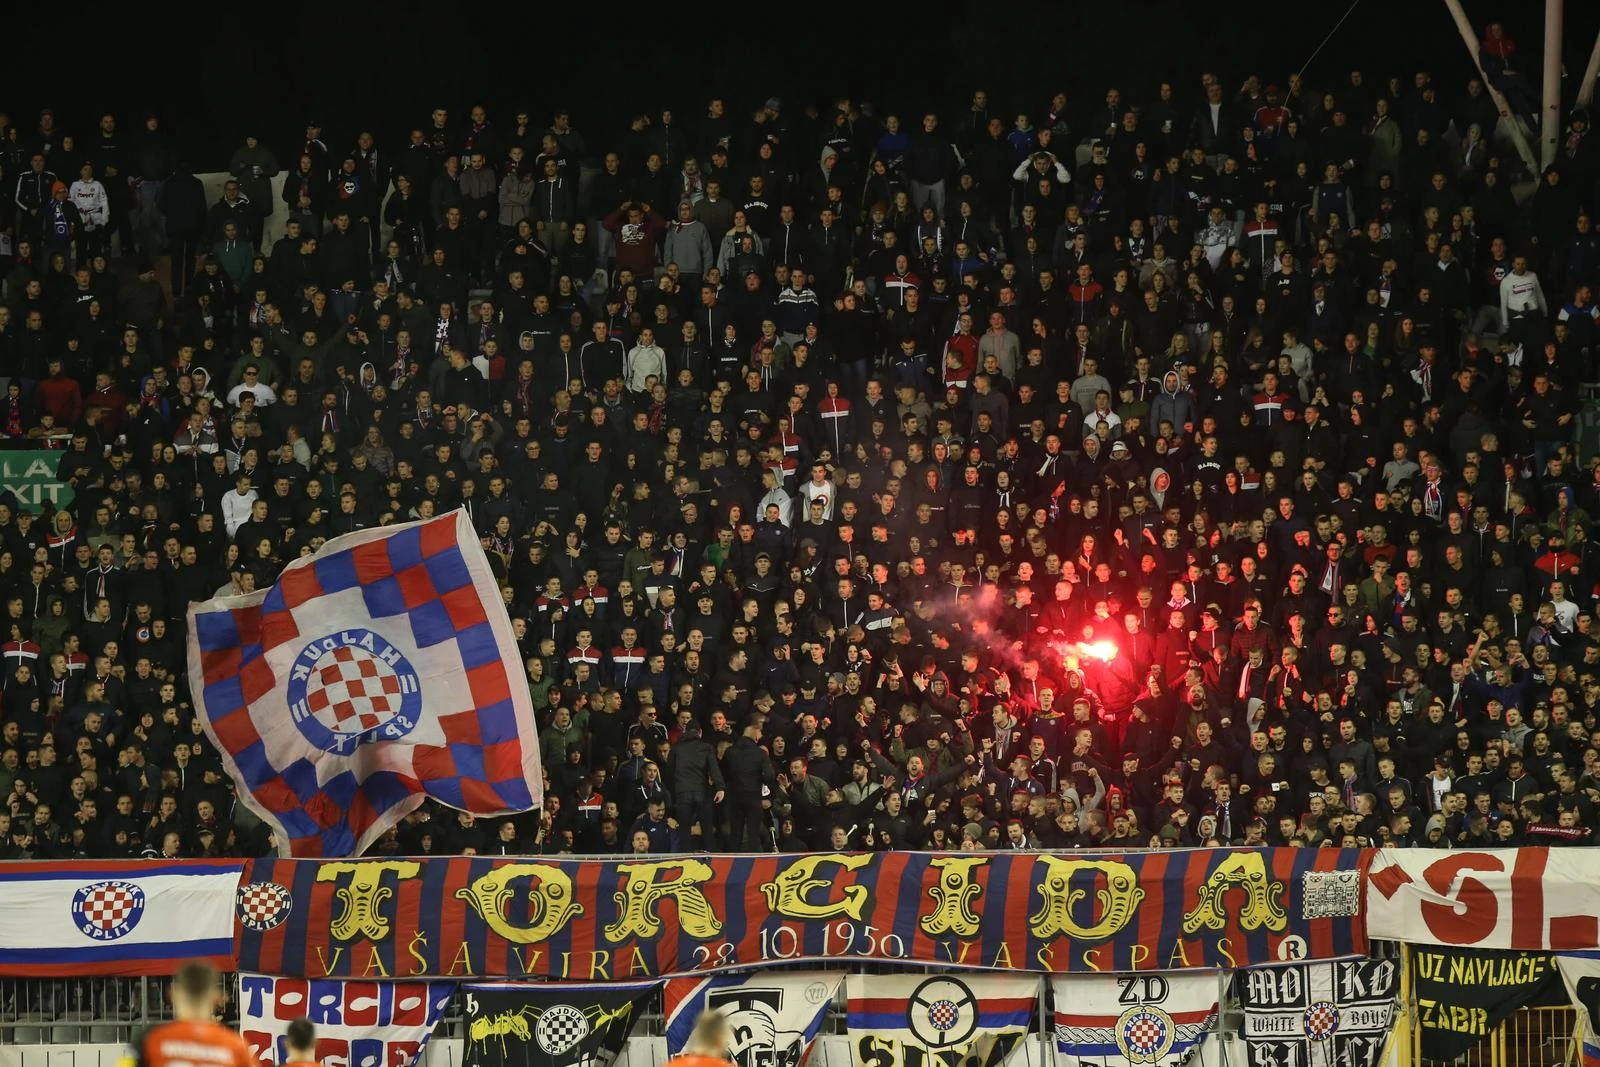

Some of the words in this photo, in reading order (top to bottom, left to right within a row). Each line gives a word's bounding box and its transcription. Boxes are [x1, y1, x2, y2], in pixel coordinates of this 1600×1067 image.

[4, 458, 60, 478] LA
[317, 852, 1287, 943] TORCIDA
[83, 922, 130, 939] SPLIT
[241, 914, 277, 930] SPLIT
[315, 929, 474, 977] VAŠA
[511, 946, 651, 980] VIRA
[759, 926, 801, 960] 10.
[821, 922, 909, 959] 1950.
[1418, 951, 1445, 983] UZ
[1449, 952, 1546, 987] NAVIJAČE
[1117, 975, 1169, 1006] ZD
[542, 1007, 584, 1024] HAJDUK
[1127, 1013, 1165, 1028] HAJDUK
[1252, 1016, 1295, 1033] WHITE
[1350, 1009, 1387, 1027] BOYS
[1419, 998, 1491, 1036] ZABR
[1129, 1044, 1159, 1055] SPLIT
